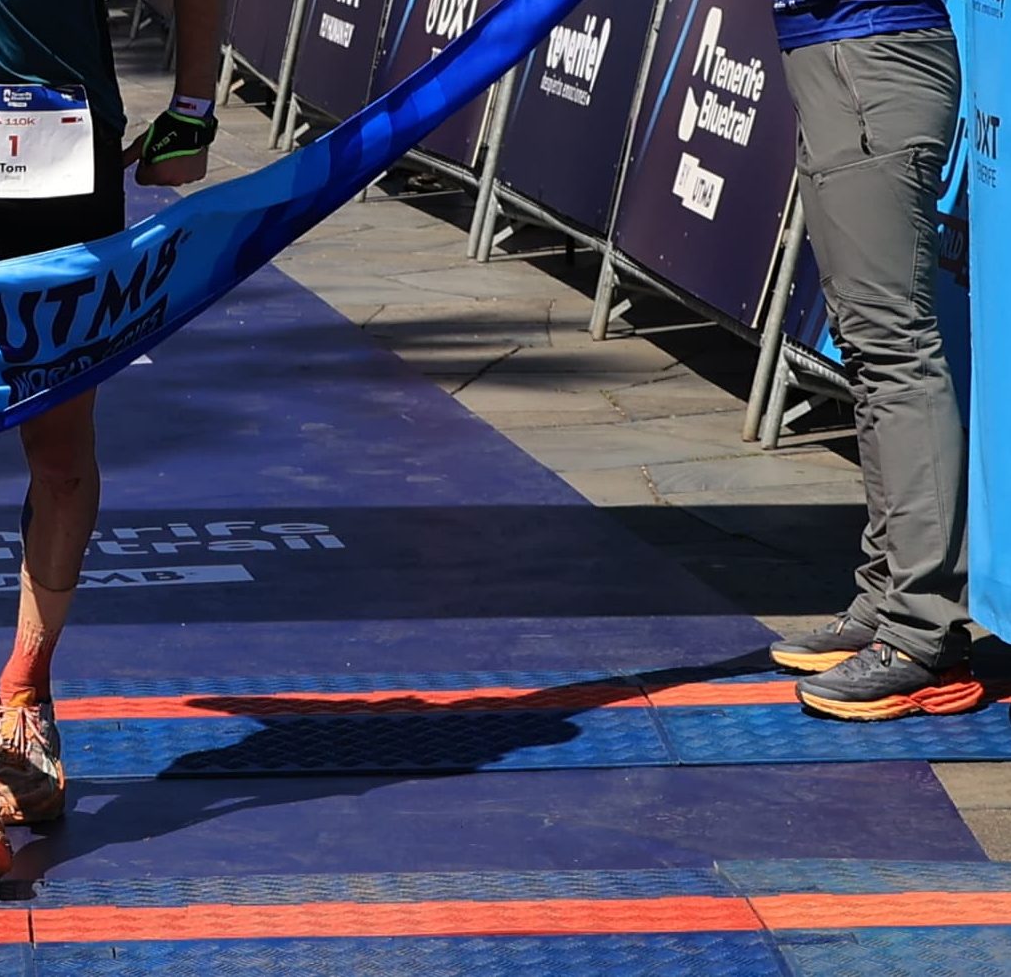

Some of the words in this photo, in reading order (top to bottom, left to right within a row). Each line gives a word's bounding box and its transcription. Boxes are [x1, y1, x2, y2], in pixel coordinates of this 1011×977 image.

[711, 46, 765, 102] Tenerife
[6, 117, 35, 126] 110K
[697, 90, 757, 147] Bluetrail
[8, 135, 18, 158] 1
[152, 131, 177, 152] LEKI
[0, 162, 27, 174] Tom
[692, 178, 716, 209] UTMB
